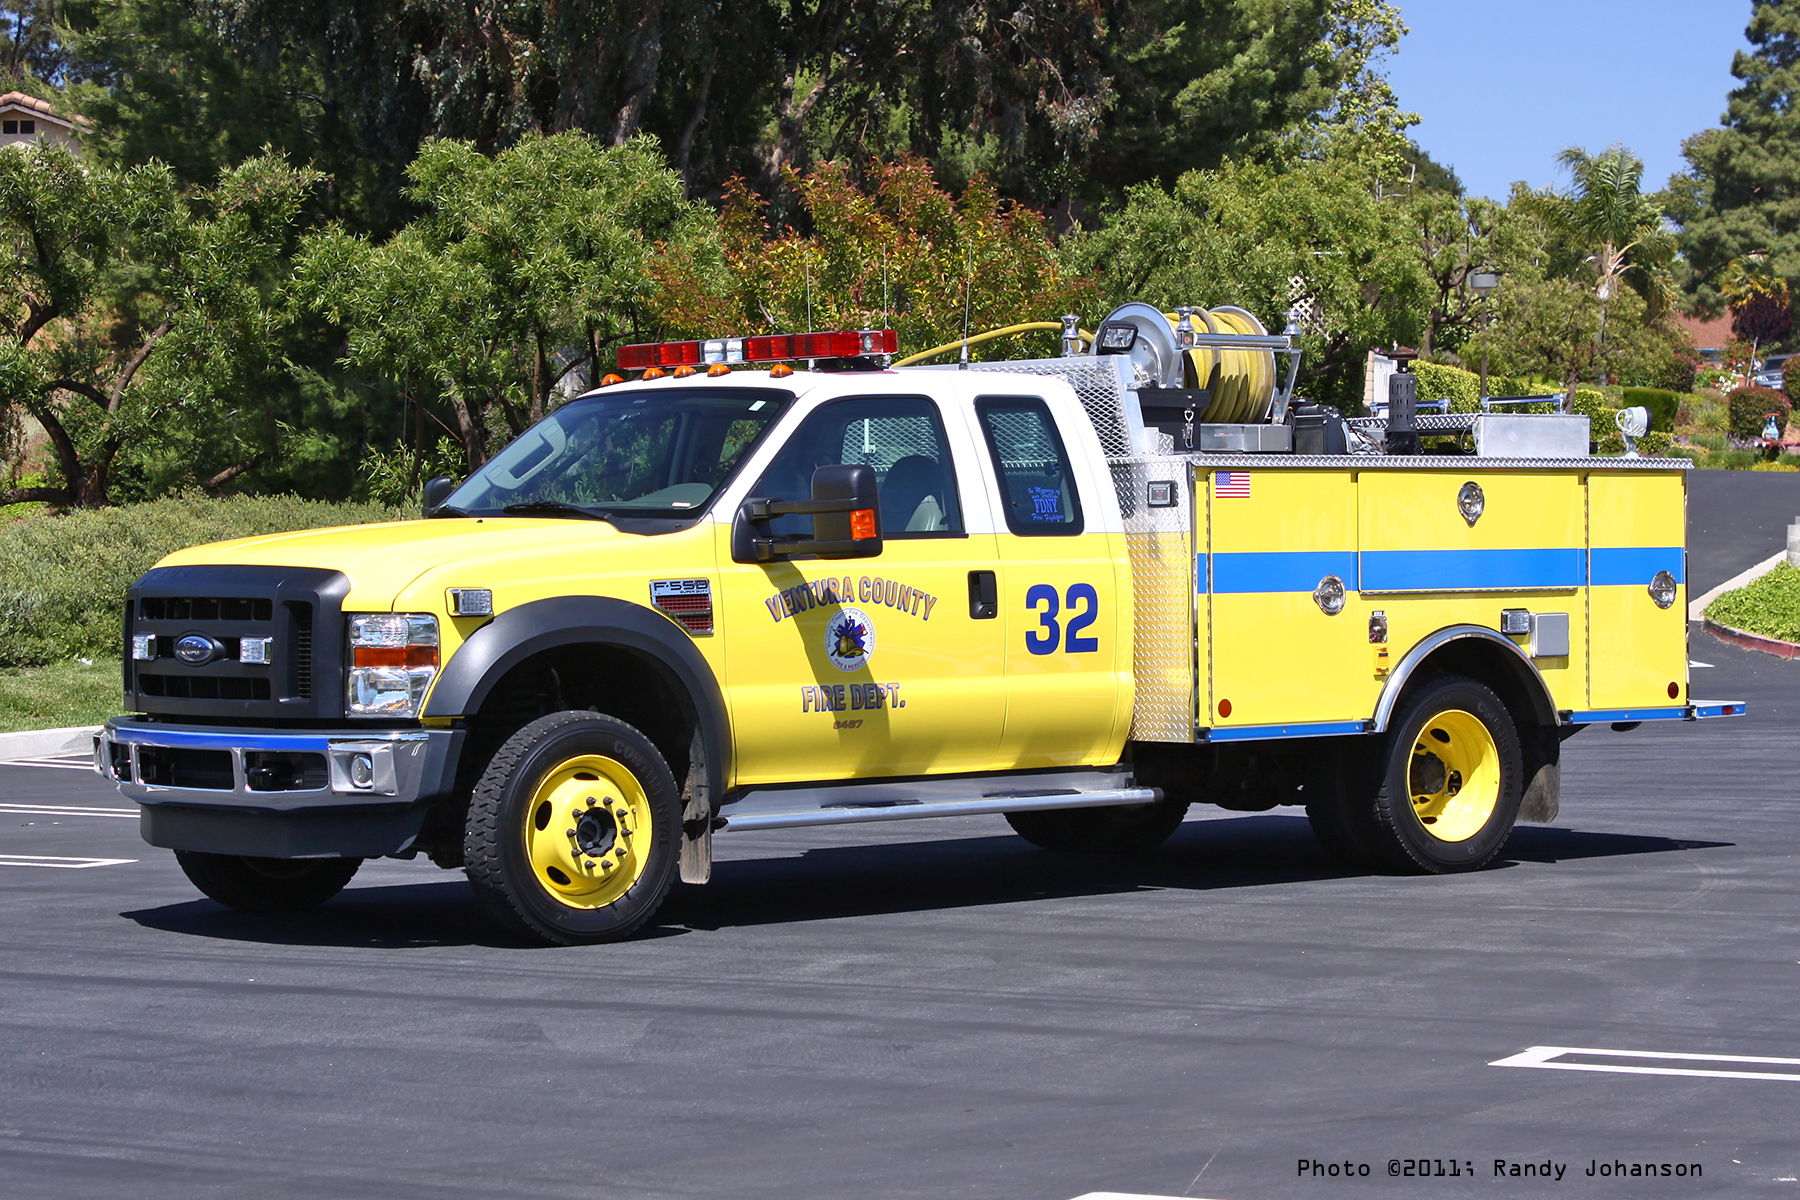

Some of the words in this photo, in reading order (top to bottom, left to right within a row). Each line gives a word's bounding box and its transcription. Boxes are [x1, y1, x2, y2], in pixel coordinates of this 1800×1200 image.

[1033, 499, 1058, 513] FDNY
[765, 576, 856, 623] VENTURA
[859, 576, 938, 621] COUNTY
[1025, 583, 1099, 656] 32
[801, 684, 846, 713] FIRE
[850, 682, 906, 711] DEPT.
